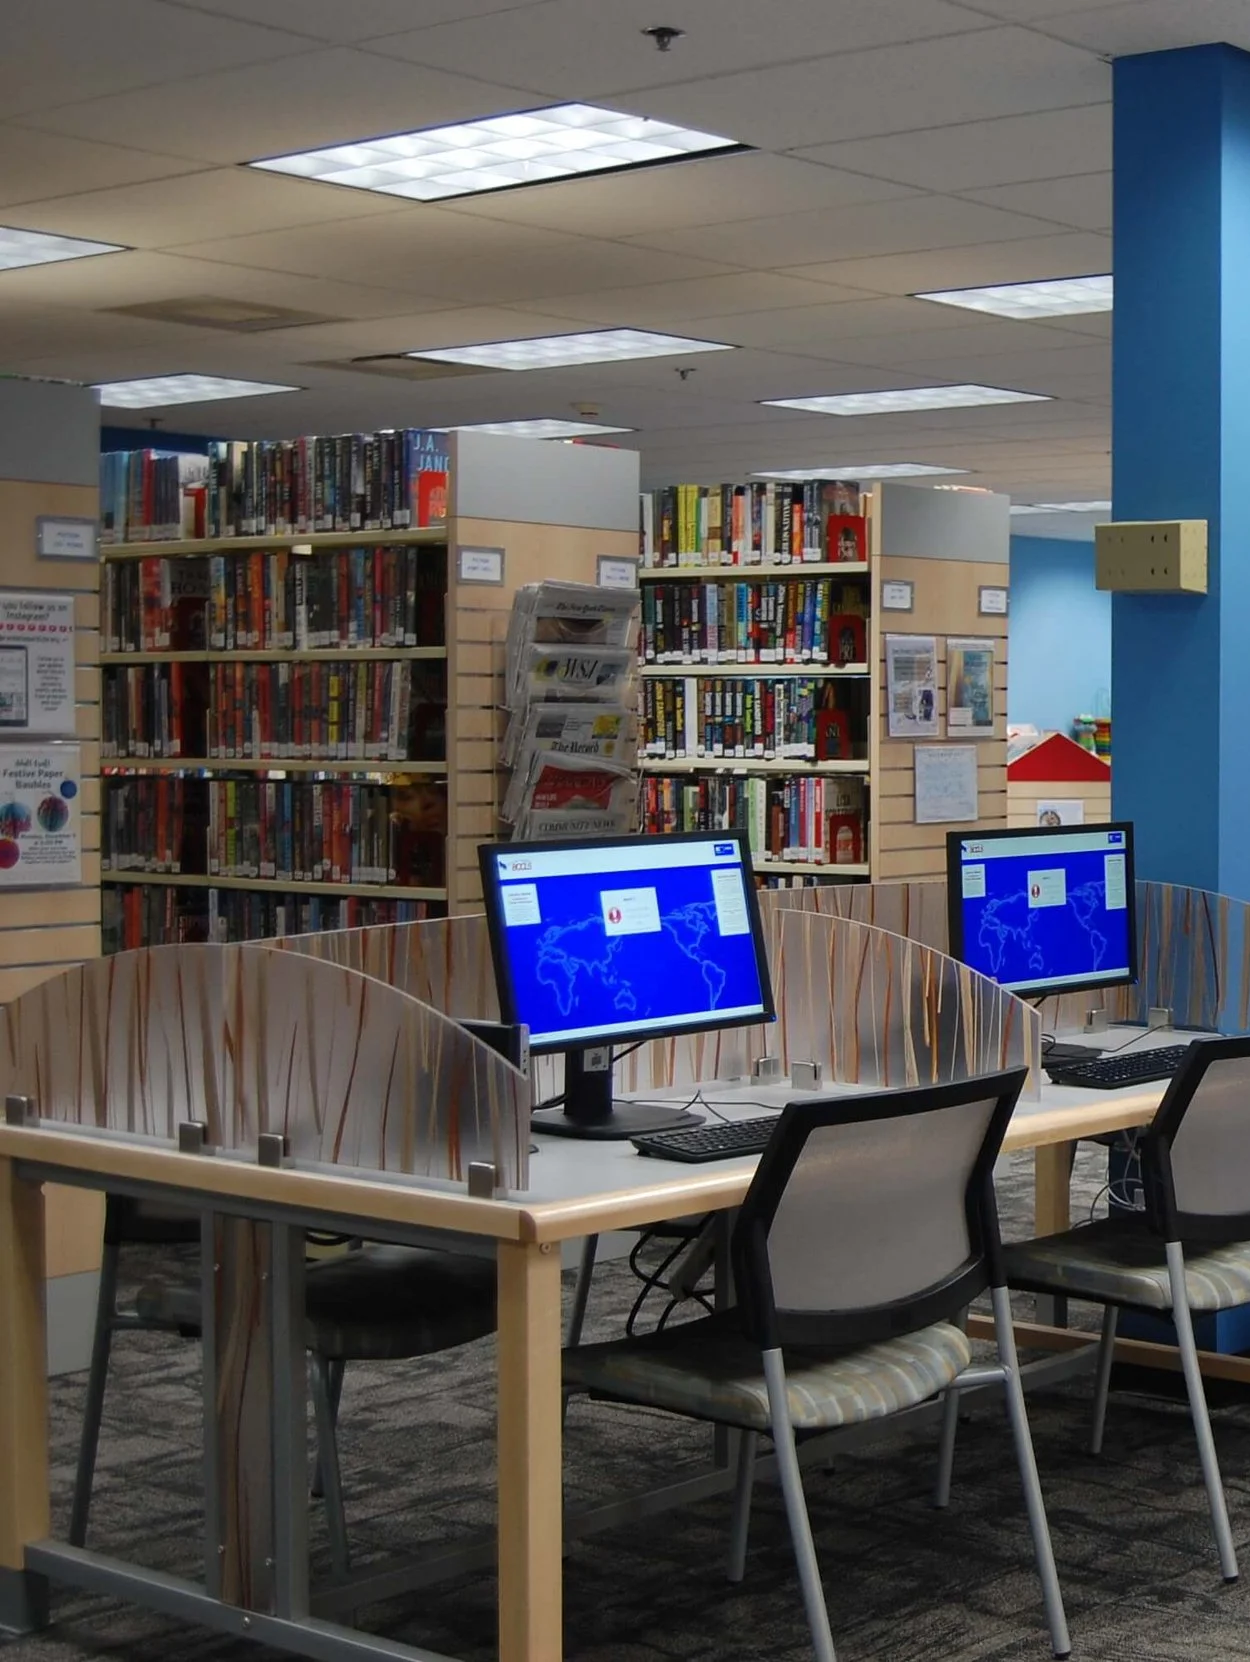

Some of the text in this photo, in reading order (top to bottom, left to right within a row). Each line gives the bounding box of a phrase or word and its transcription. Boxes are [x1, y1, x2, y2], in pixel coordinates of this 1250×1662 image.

[413, 433, 439, 452] J.A.
[569, 741, 599, 754] Record
[3, 769, 64, 780] Festive Paper
